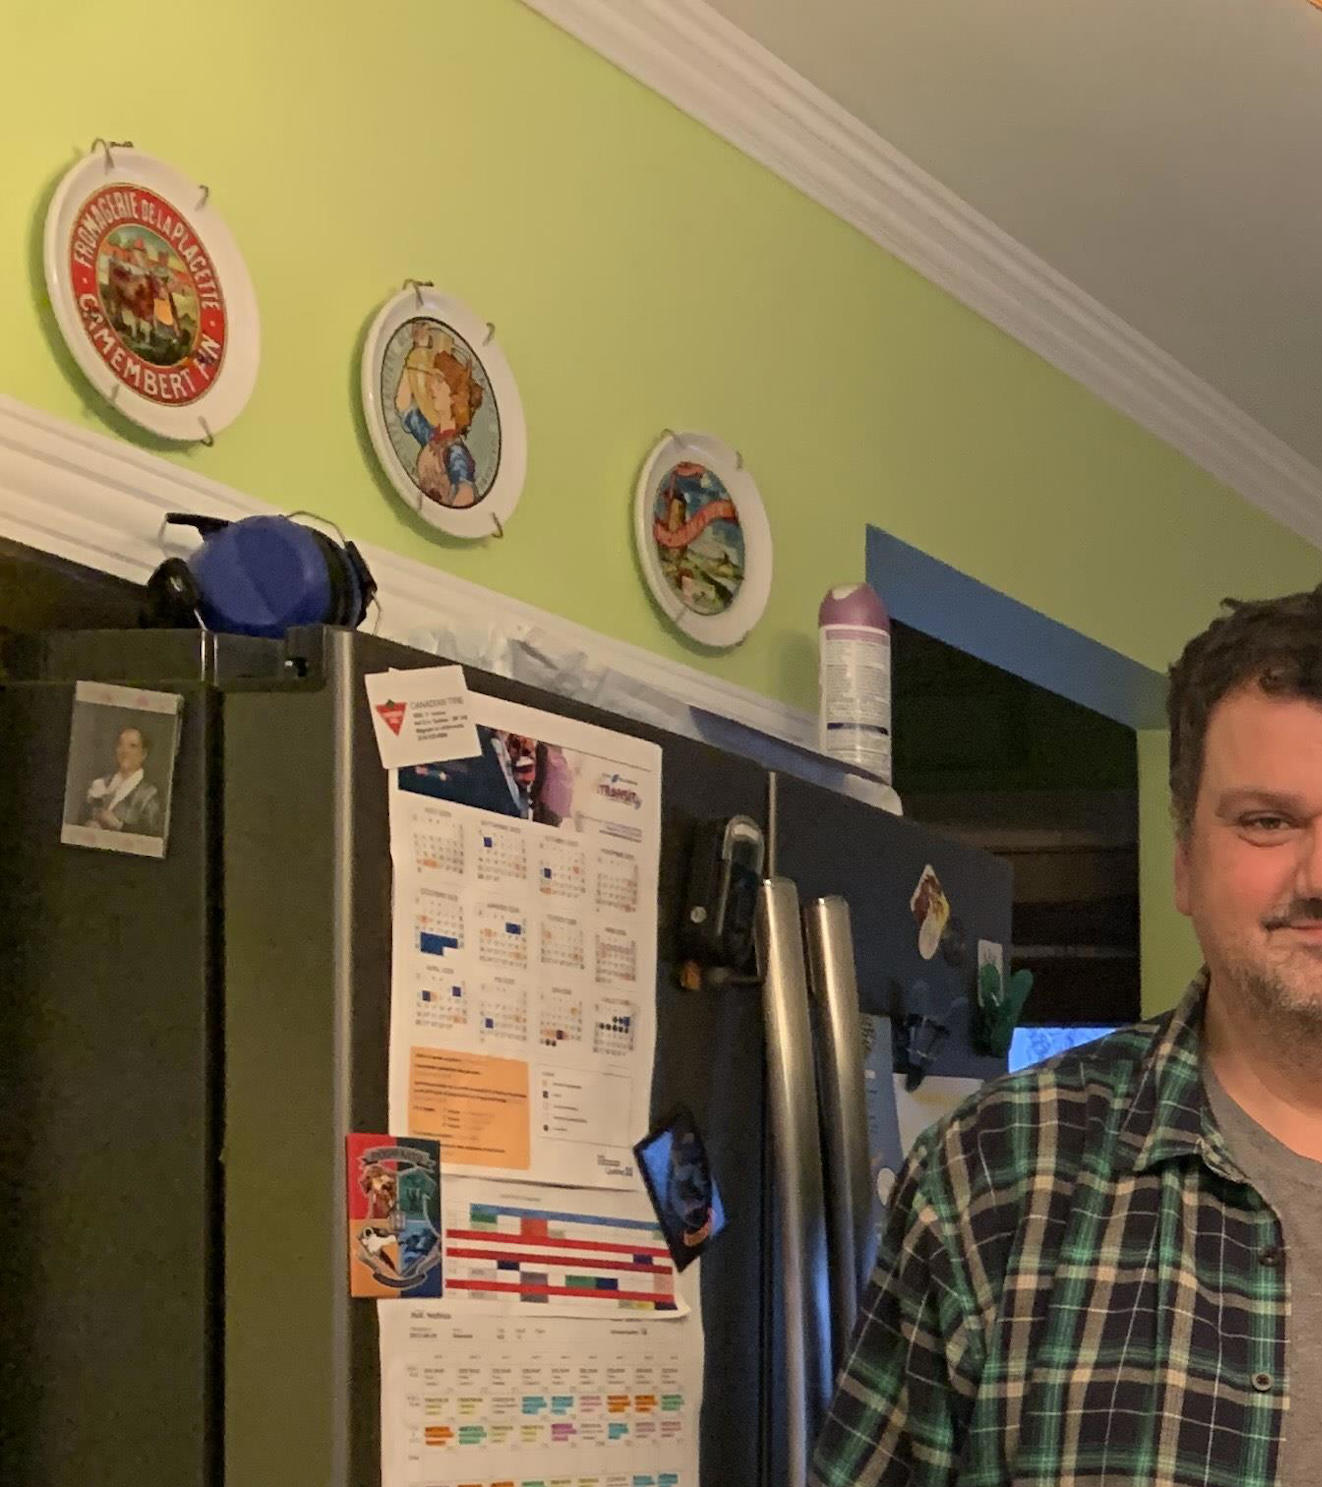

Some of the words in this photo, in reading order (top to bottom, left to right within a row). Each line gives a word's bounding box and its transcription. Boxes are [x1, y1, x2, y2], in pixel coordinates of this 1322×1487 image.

[74, 191, 139, 268] FROMAGERIE
[157, 215, 174, 236] LA
[171, 222, 220, 310] PLACETTE
[79, 293, 196, 400] CAMEMBERT
